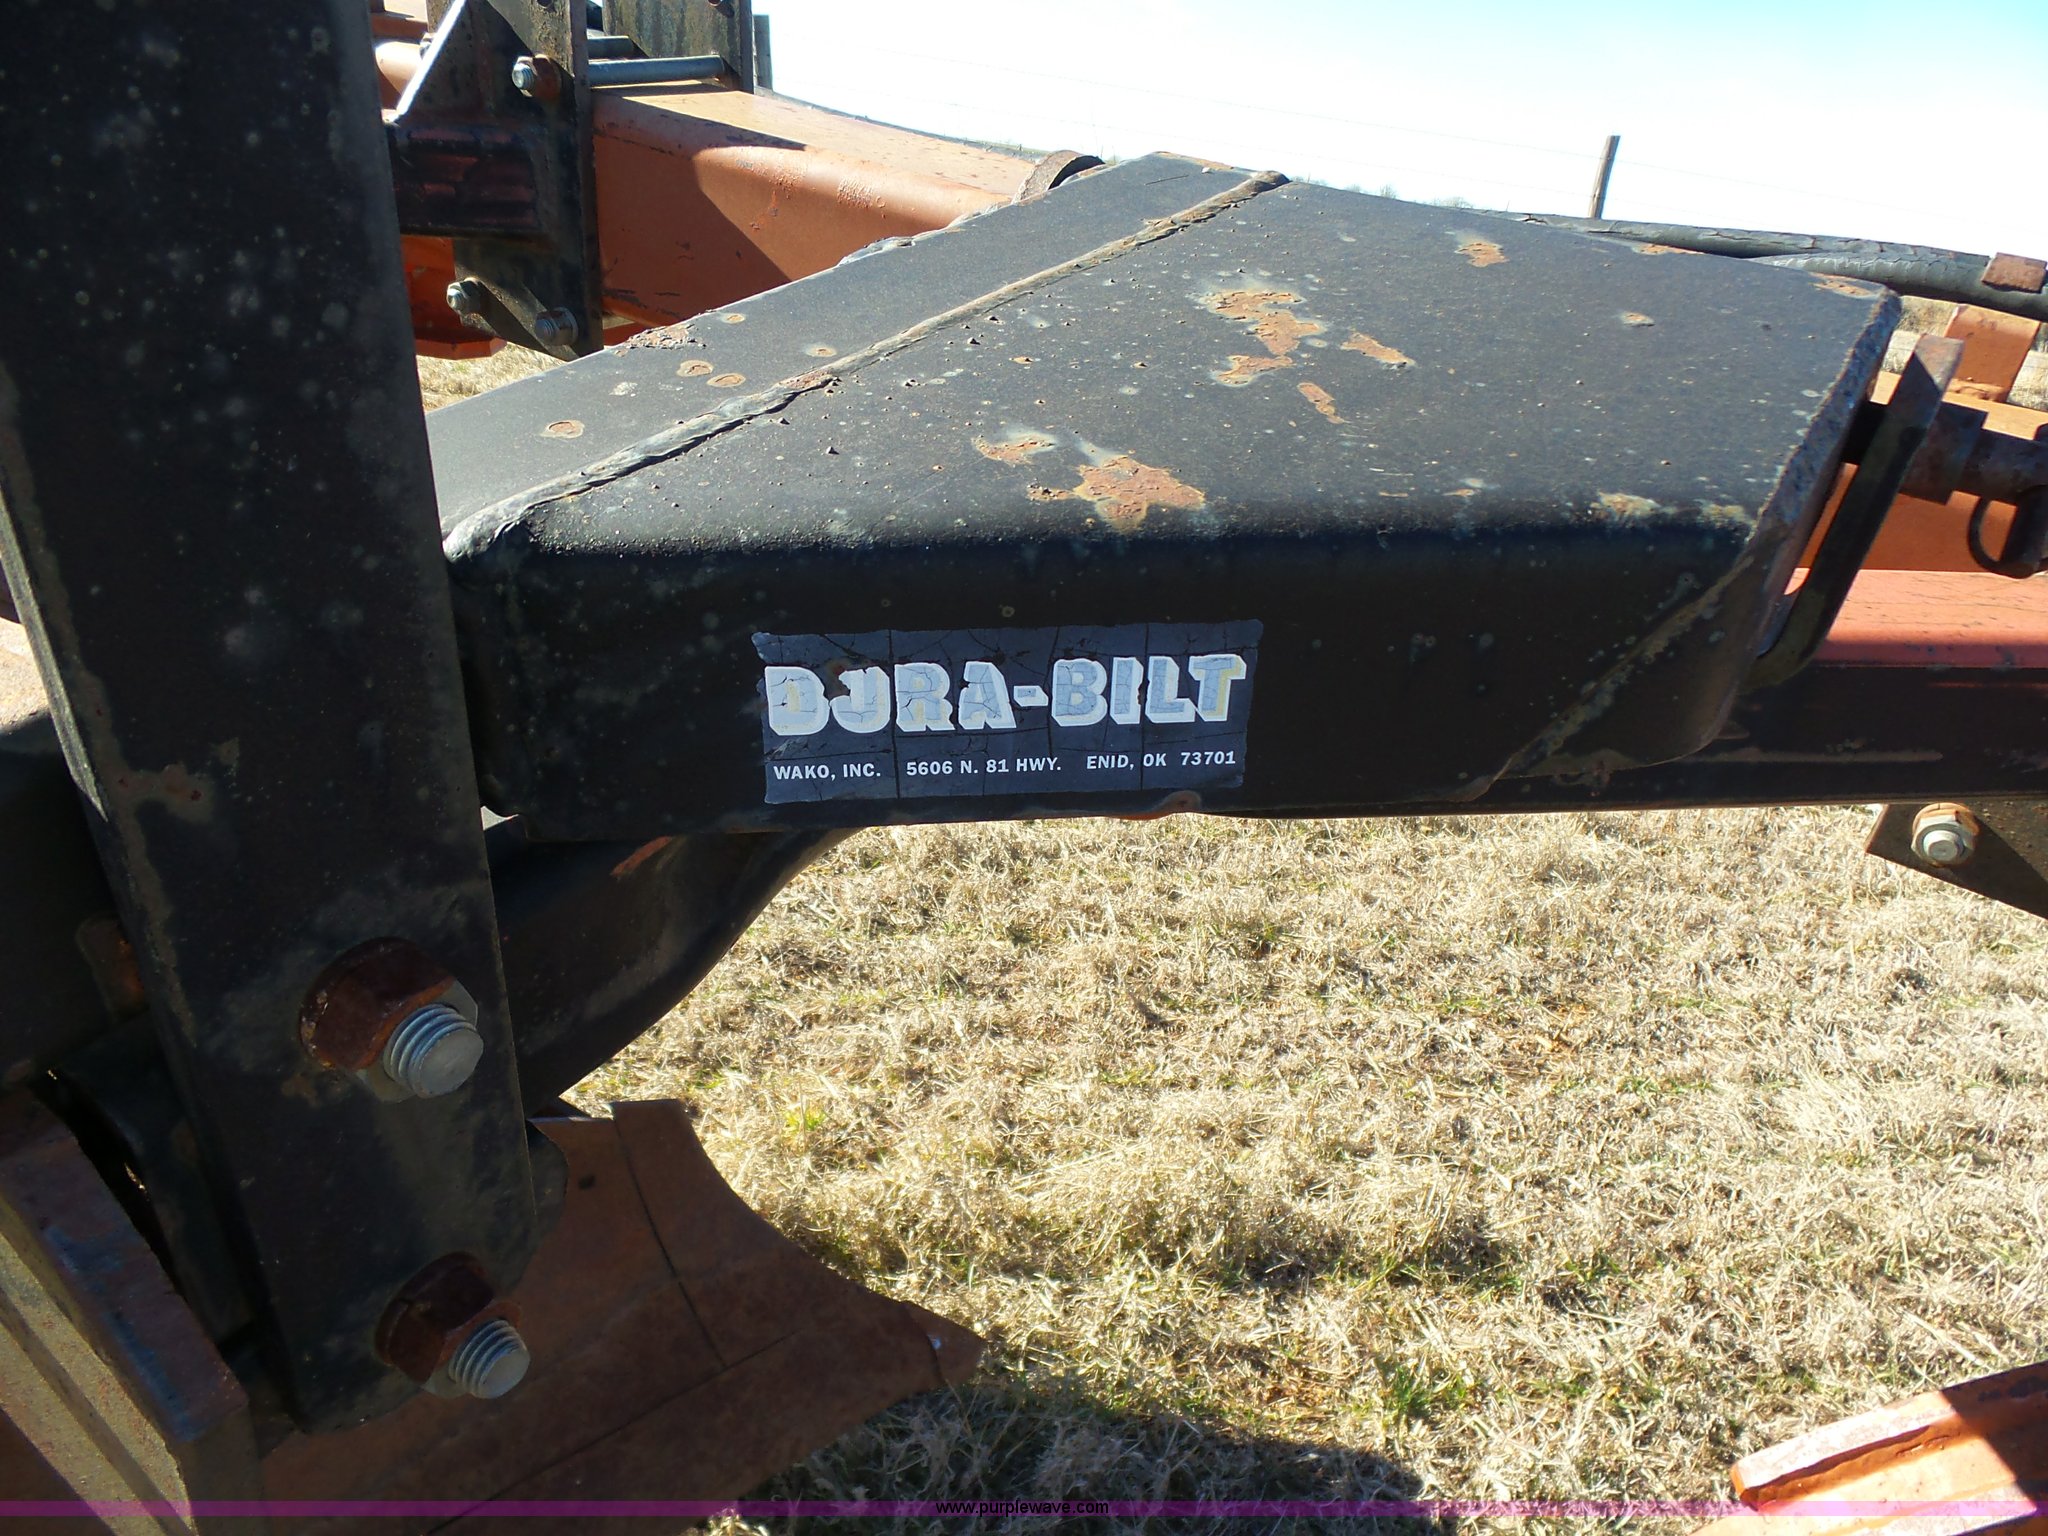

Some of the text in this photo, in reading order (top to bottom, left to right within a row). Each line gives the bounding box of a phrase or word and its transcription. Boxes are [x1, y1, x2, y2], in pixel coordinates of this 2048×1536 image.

[773, 750, 1236, 781] WAKO, INC. 5606 N. 81 HWY. ENID, OK 73701
